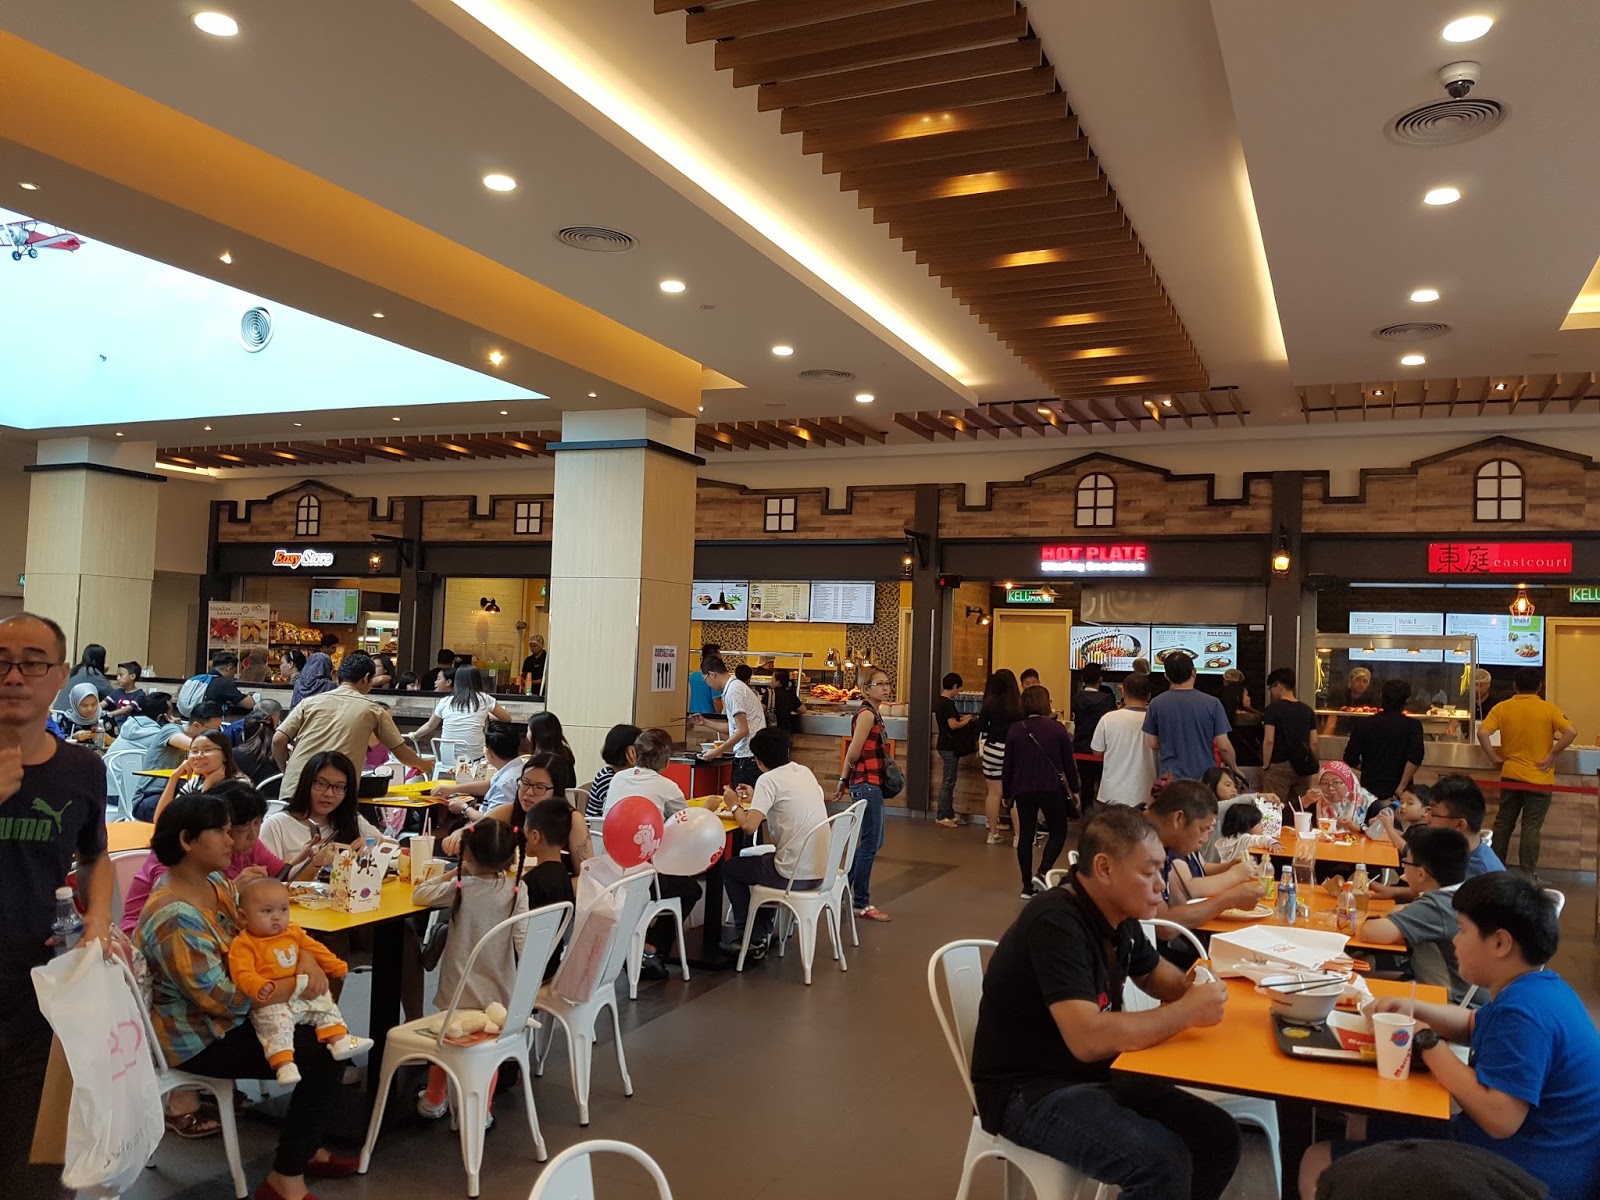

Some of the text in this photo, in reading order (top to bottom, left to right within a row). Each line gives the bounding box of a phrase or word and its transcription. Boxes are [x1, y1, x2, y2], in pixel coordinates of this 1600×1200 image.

[273, 550, 333, 568] Easy Store
[1041, 546, 1147, 560] HOT PLATE
[1437, 544, 1567, 572] 東庭 eastcourt
[1573, 588, 1600, 600] KELU
[0, 817, 52, 841] UMA
